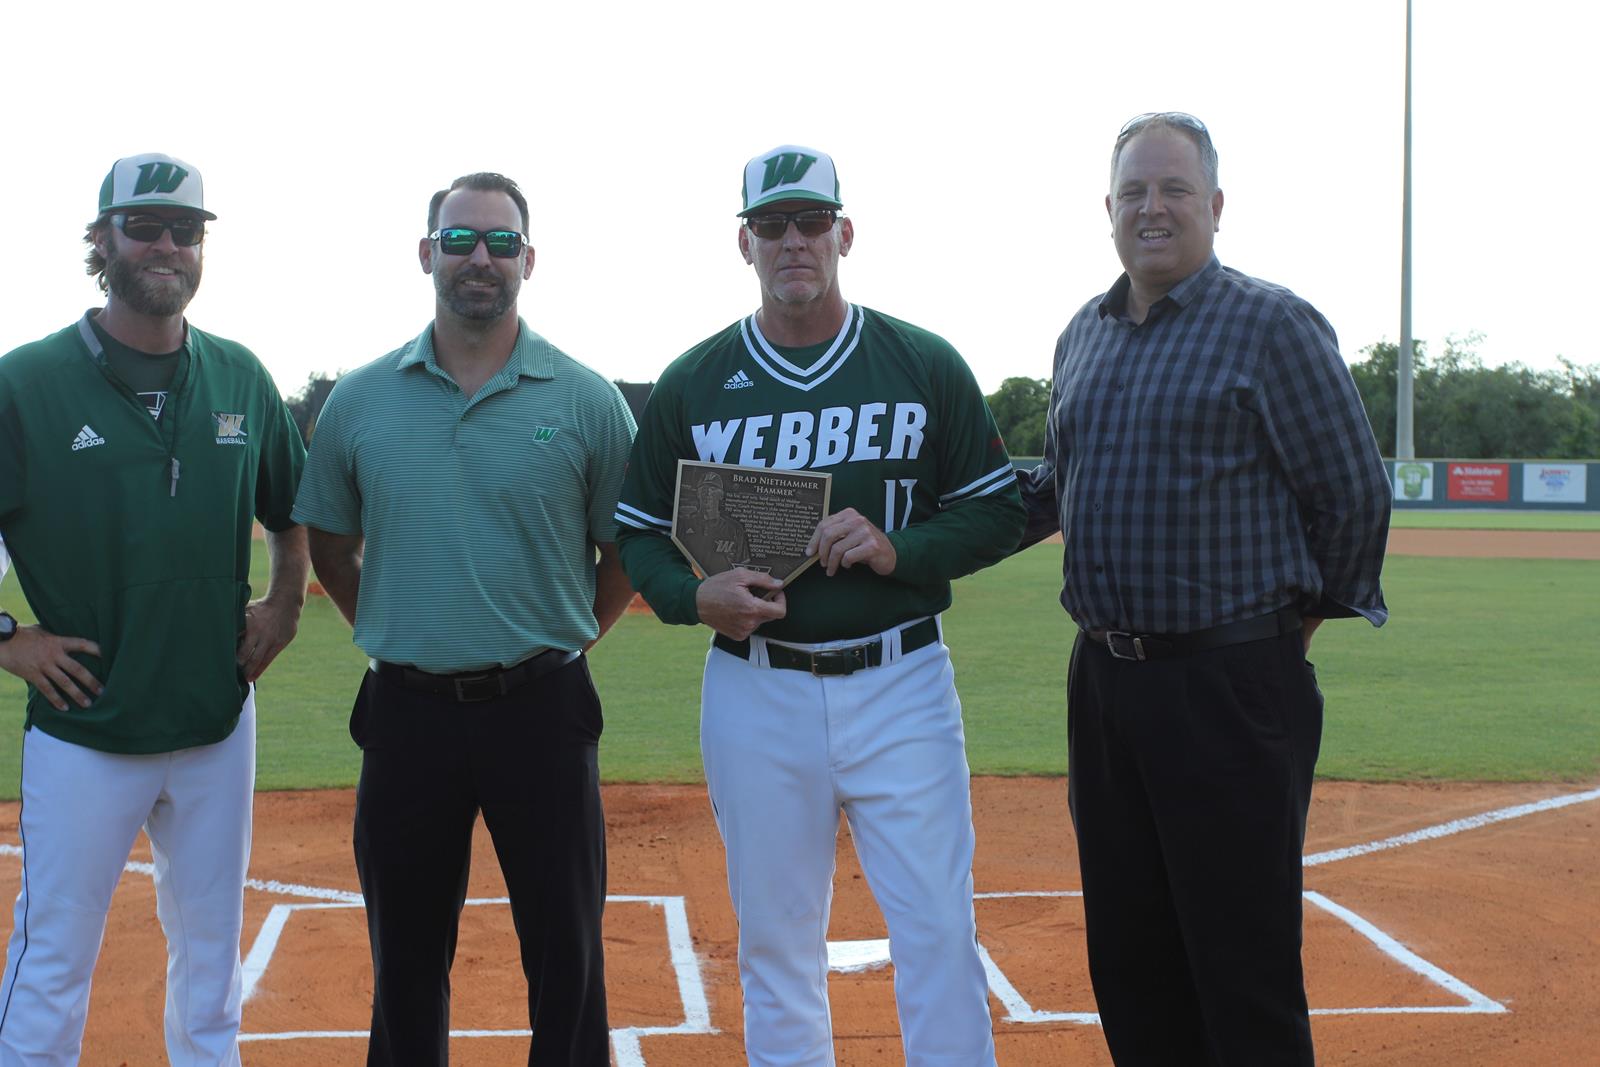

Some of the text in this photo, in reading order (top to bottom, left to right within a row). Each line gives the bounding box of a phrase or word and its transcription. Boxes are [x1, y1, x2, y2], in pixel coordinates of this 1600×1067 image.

[132, 162, 189, 197] W
[760, 152, 818, 194] W
[724, 380, 754, 389] adidas
[216, 437, 247, 445] BASEBALL
[533, 426, 559, 442] W
[691, 402, 927, 470] WEBBER
[71, 435, 105, 451] adidas
[733, 474, 820, 490] BRAD NIETHAMMER
[884, 479, 918, 533] 17
